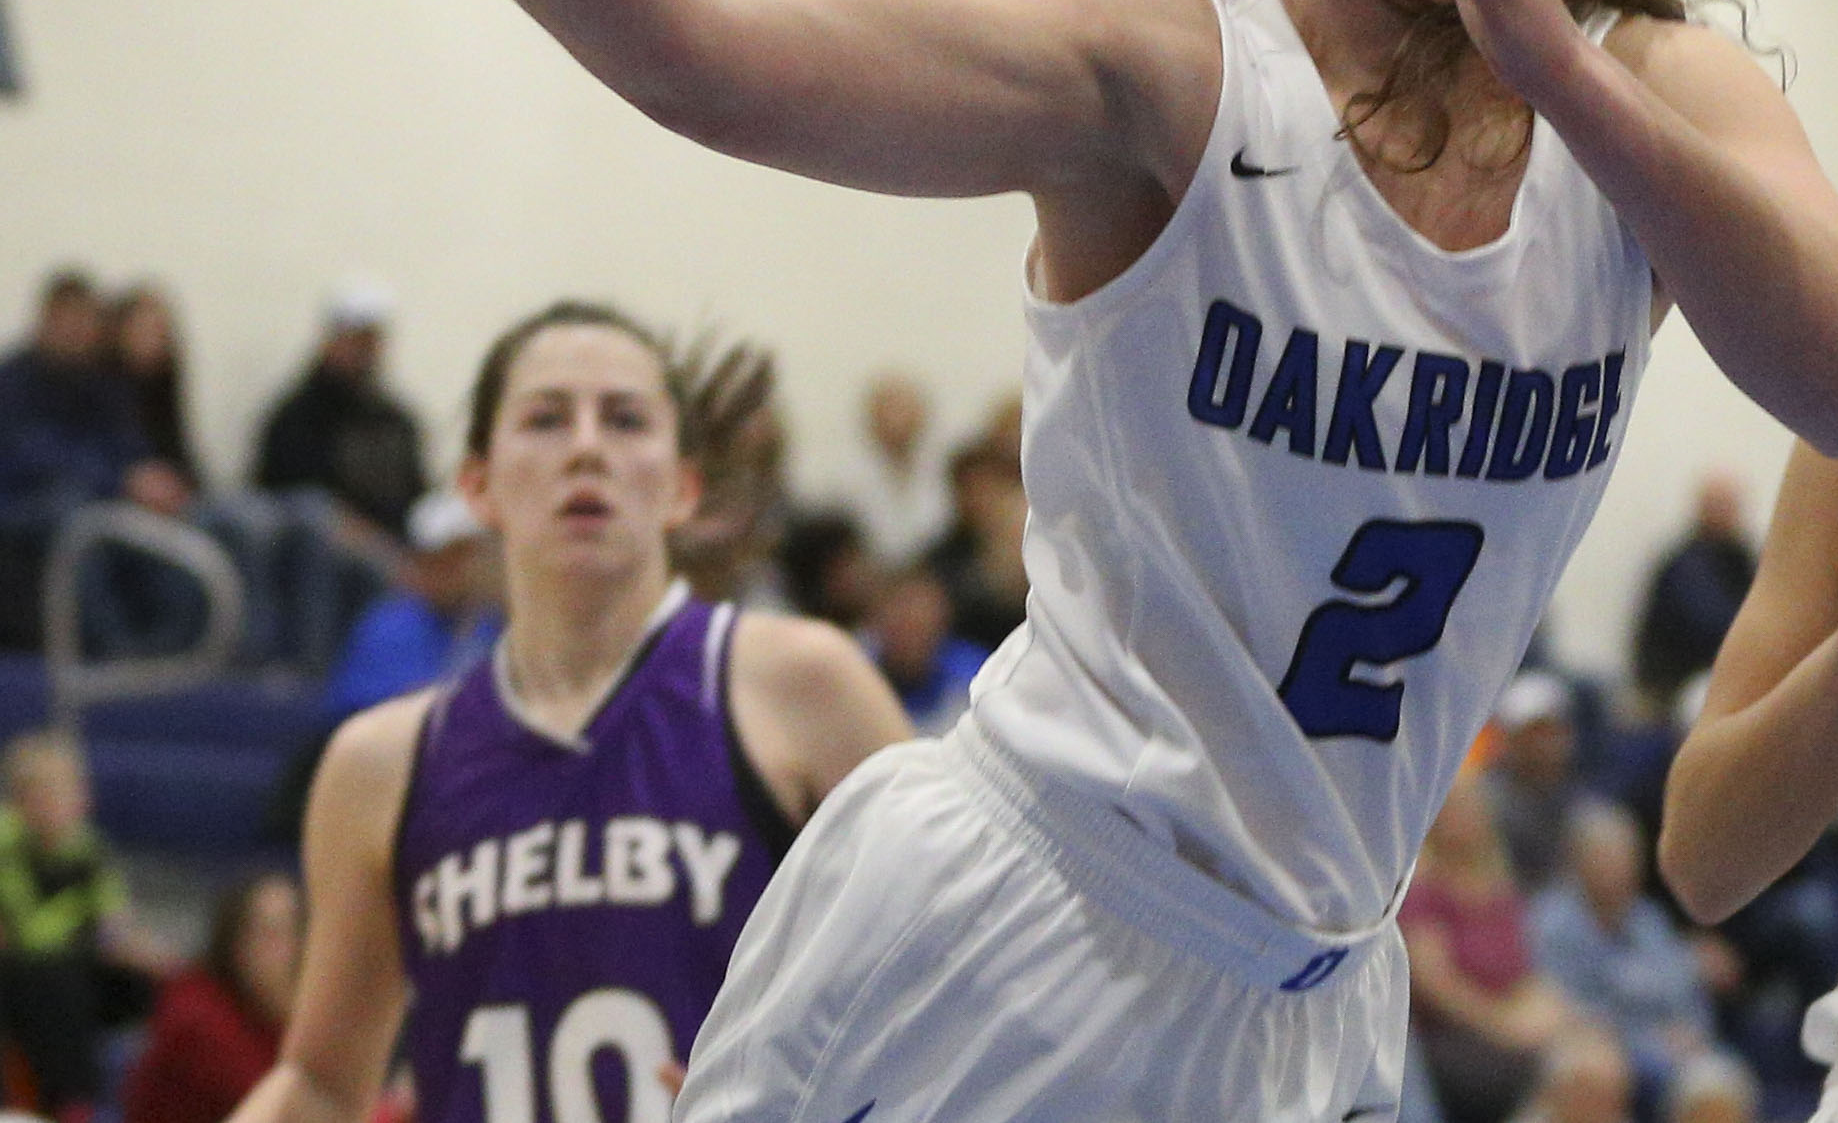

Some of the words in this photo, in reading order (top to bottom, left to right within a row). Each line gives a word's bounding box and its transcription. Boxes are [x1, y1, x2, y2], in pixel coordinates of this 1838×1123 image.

[1187, 298, 1626, 483] OAKRIDGE
[1278, 518, 1485, 744] 2
[459, 986, 680, 1123] 10
